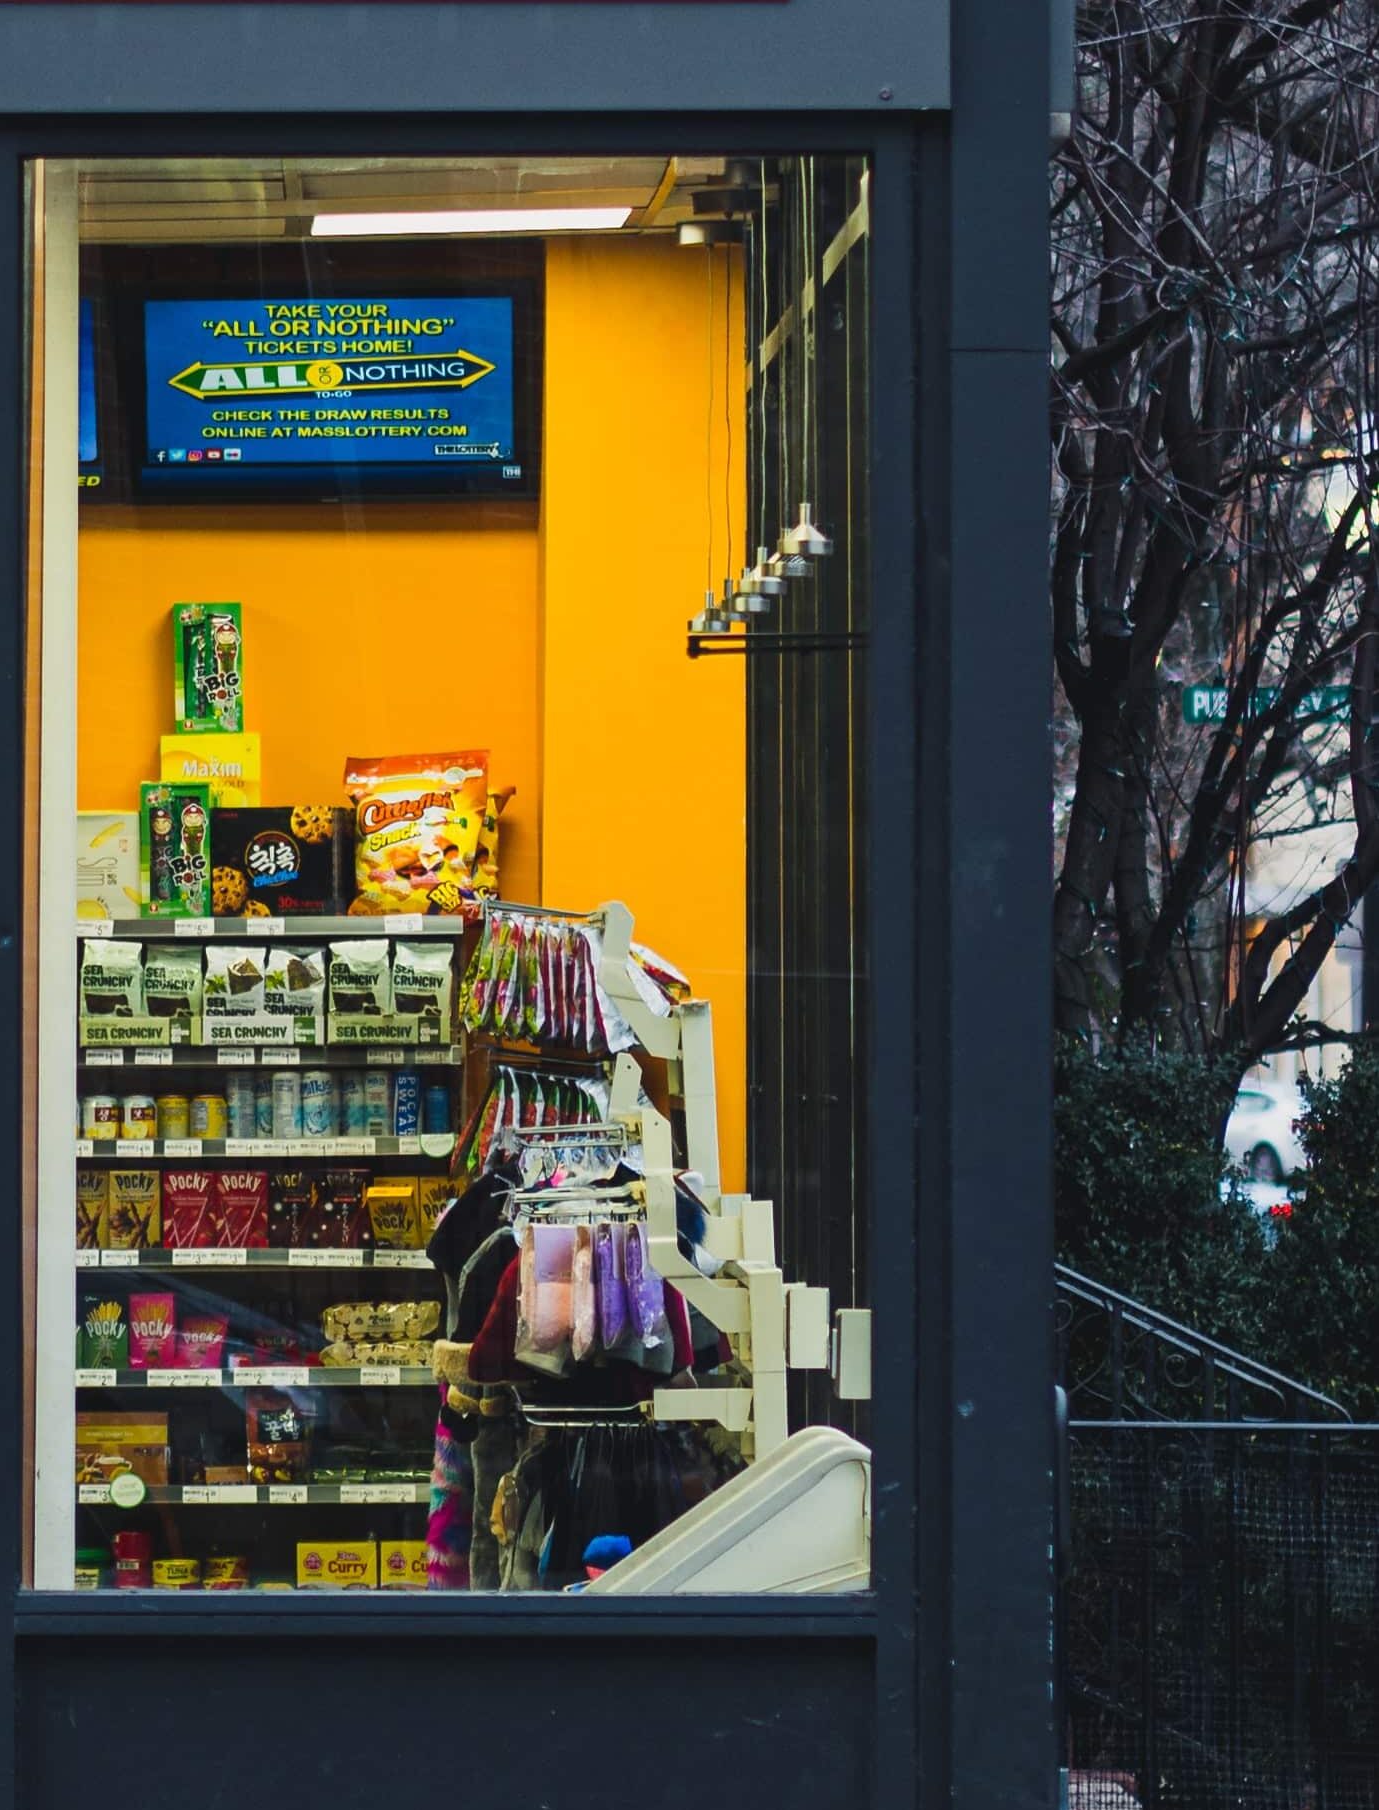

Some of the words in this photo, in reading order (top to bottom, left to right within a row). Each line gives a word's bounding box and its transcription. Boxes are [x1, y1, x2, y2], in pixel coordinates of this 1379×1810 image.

[264, 304, 321, 318] TAKE
[326, 304, 387, 318] YOUR
[270, 319, 311, 336] OR
[244, 340, 337, 354] TICKETS
[342, 340, 413, 353] HOME!
[199, 365, 308, 390] ALL
[318, 366, 332, 385] OR
[346, 361, 465, 382] NOTHING
[212, 410, 272, 421] CHECK
[278, 410, 310, 420] THE
[315, 409, 367, 420] DRAW
[371, 409, 449, 420] RESULTS
[202, 427, 267, 438] ONLINE
[272, 427, 293, 438] AT
[181, 757, 242, 777] Maxim
[370, 823, 422, 852] Snack
[431, 881, 460, 902] BIG
[83, 965, 104, 975] SEA
[145, 967, 166, 978] SEA
[331, 963, 350, 974] SEA
[395, 964, 415, 974] SEA
[83, 976, 133, 988] CRUNCHY
[145, 979, 195, 991] CRUNCHY
[331, 974, 379, 986] CRUNCHY
[394, 976, 444, 989] CRUNCHY
[206, 997, 227, 1008] SEA
[264, 993, 284, 1004] SEA
[264, 1004, 315, 1016] CRUNCHY
[87, 1028, 108, 1039] SEA
[110, 1027, 163, 1039] CRUNCHY
[211, 1027, 231, 1039] SEA
[234, 1026, 288, 1038] CRUNCHY
[336, 1026, 357, 1038] SEA
[359, 1026, 412, 1038] CRUNCHY
[406, 1076, 416, 1136] POCAR
[327, 1561, 368, 1576] Curry
